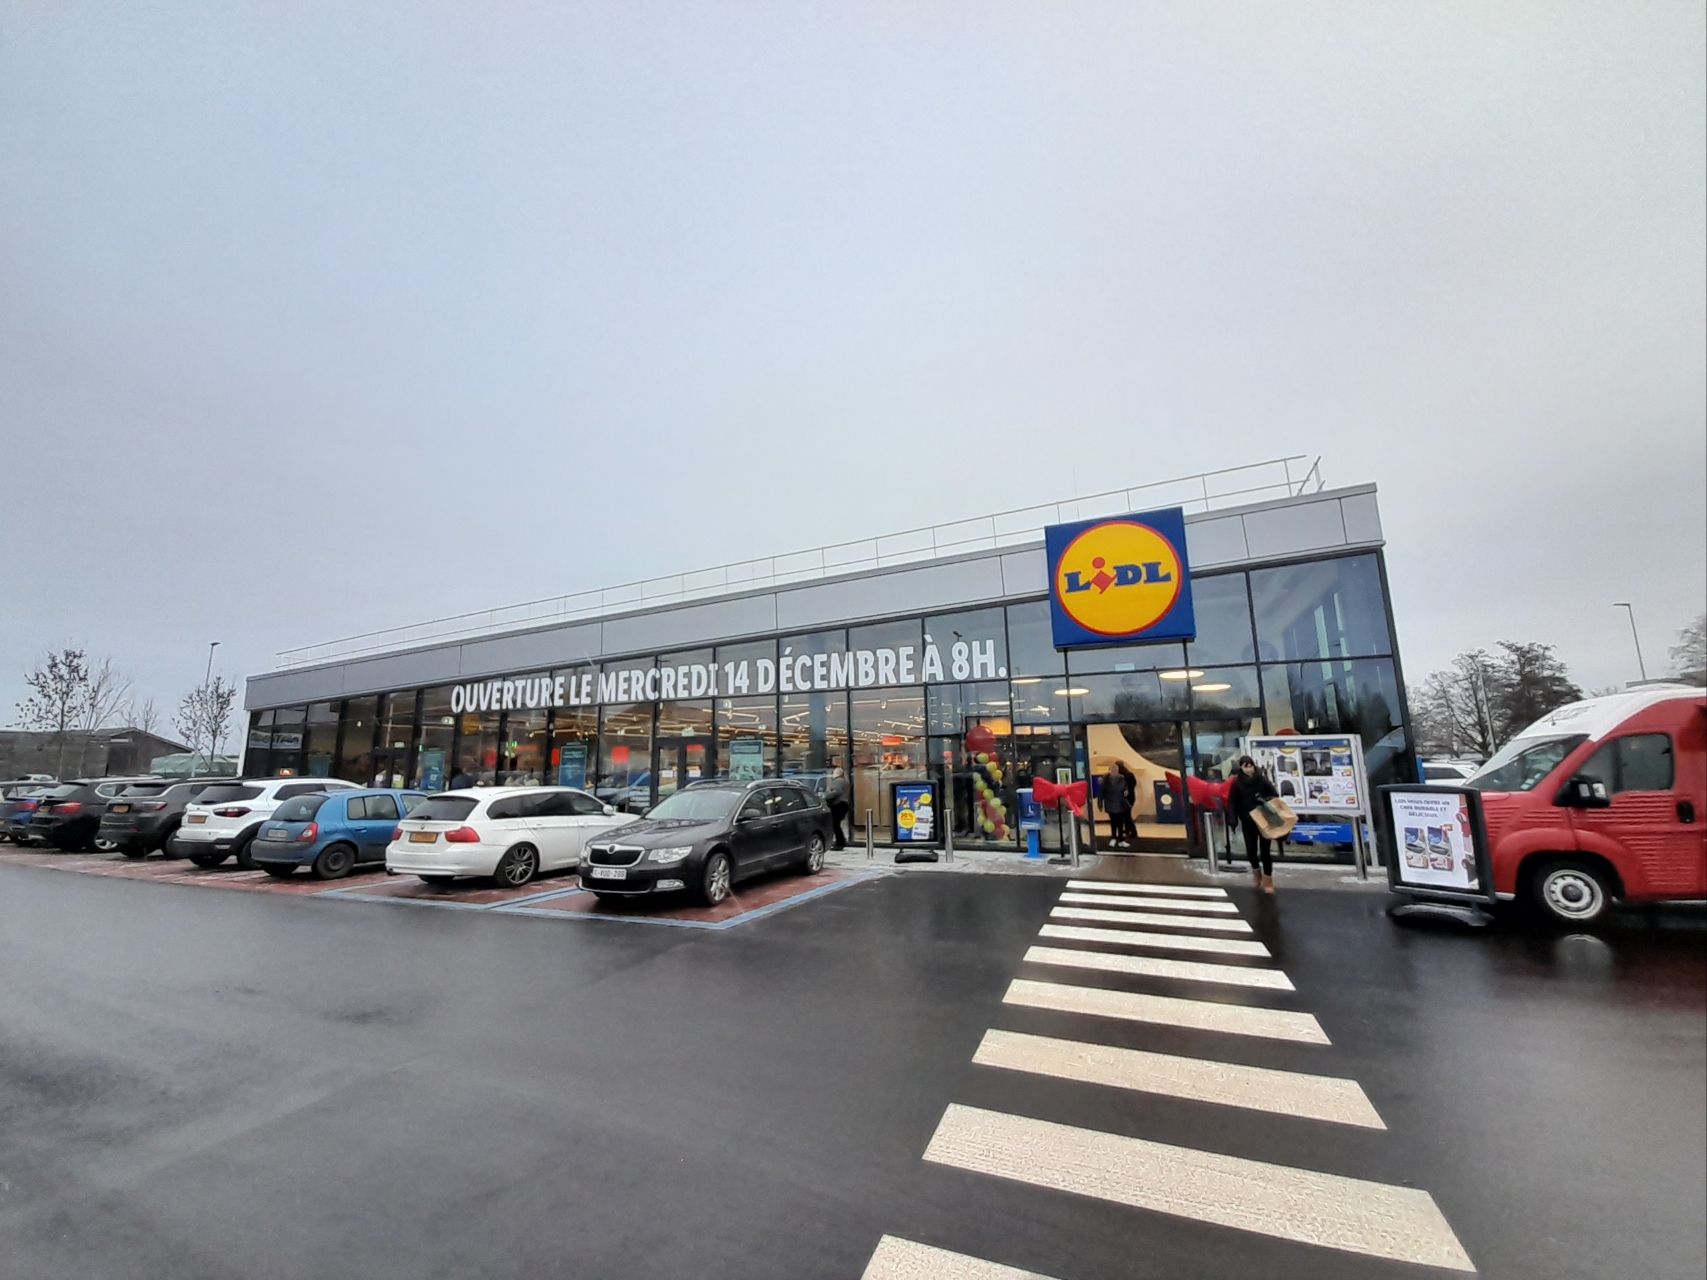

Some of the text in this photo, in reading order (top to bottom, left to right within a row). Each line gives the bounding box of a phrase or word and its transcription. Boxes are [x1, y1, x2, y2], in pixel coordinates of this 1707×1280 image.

[451, 634, 1008, 713] OUVERTURE LE MERCREDI 14 DÉCEMBRE À 8H.
